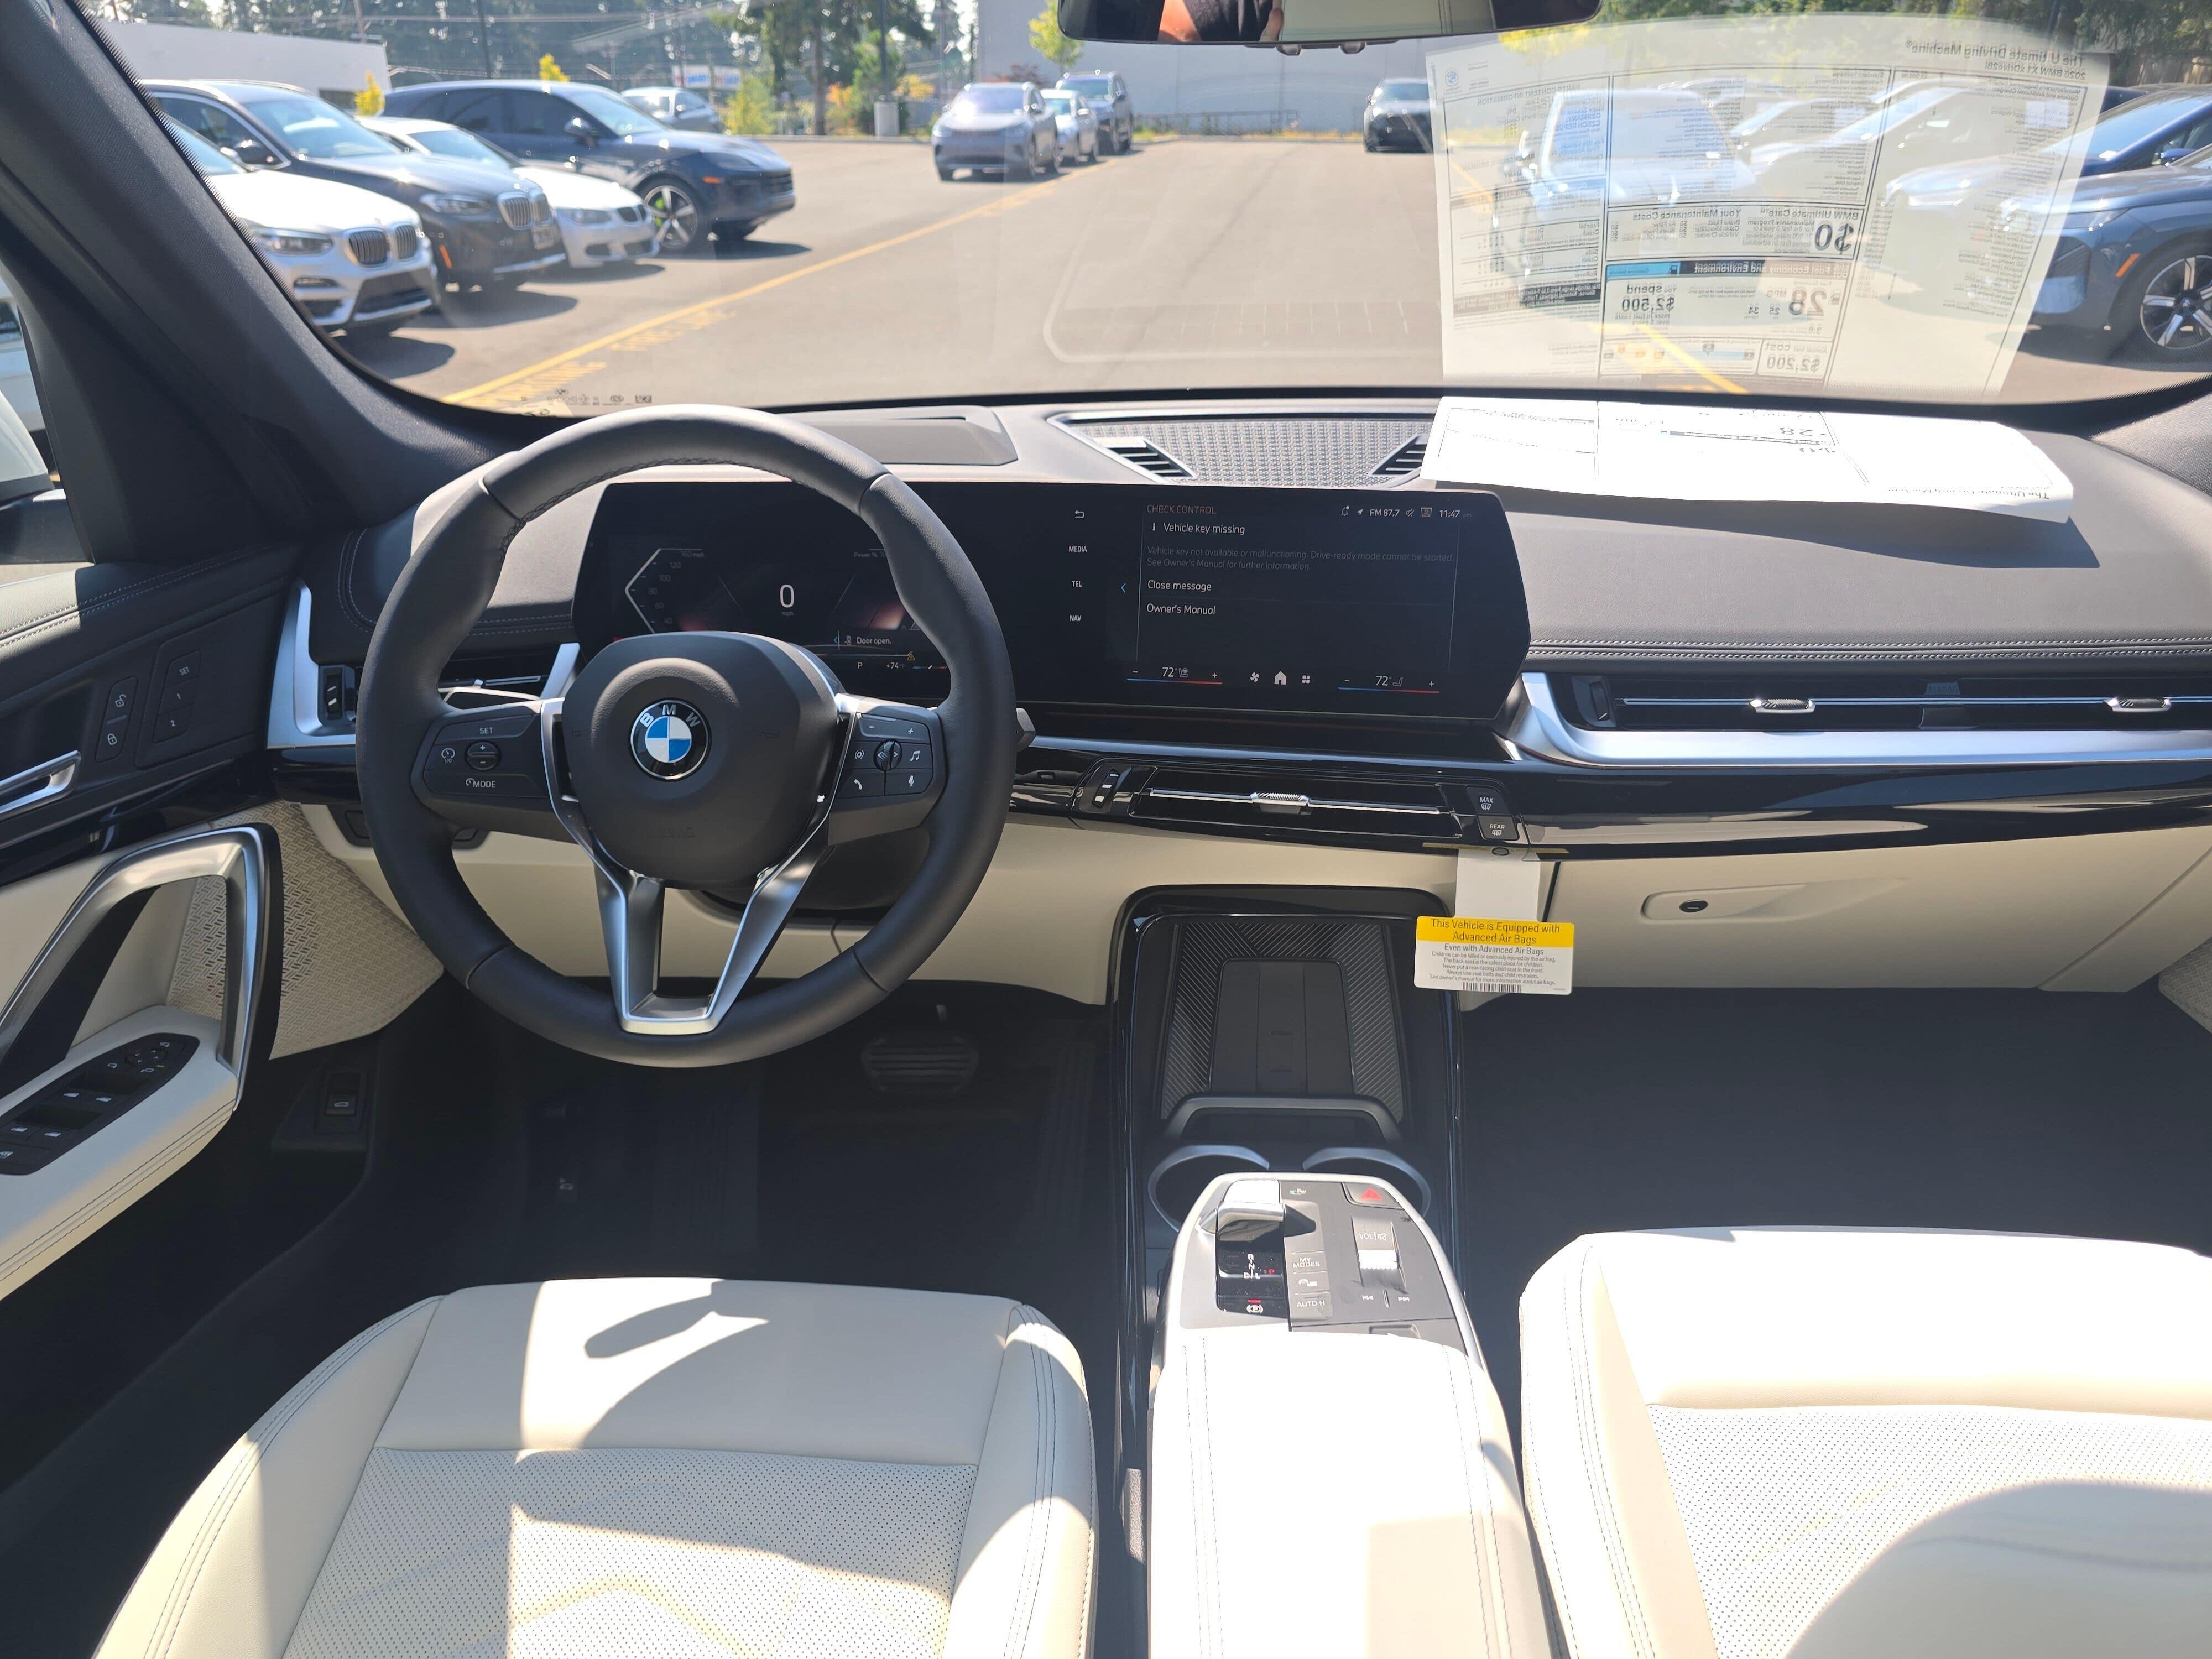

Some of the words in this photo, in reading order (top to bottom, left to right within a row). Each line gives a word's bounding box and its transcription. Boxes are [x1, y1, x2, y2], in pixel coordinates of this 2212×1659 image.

[1147, 505, 1175, 513] CHECK
[1176, 505, 1217, 514] CONTROL
[1439, 509, 1460, 518] 11:47
[1163, 523, 1193, 533] Vehicle
[1195, 524, 1211, 534] key
[1212, 525, 1245, 535] missing
[1147, 546, 1173, 555] Vehicle
[1176, 547, 1188, 556] key
[1206, 548, 1238, 557] available
[1250, 549, 1308, 560] malfunctioning.
[1311, 551, 1355, 561] Drive-ready
[1424, 553, 1454, 562] started.
[1164, 558, 1195, 567] Owner's
[1197, 559, 1225, 567] Manual
[1227, 560, 1237, 568] for
[1239, 560, 1264, 569] further
[1265, 561, 1312, 570] information.
[1147, 580, 1170, 589] Close
[1172, 582, 1212, 592] message
[779, 585, 795, 608] 0
[1147, 603, 1181, 613] Owner's
[1183, 604, 1215, 614] Manual
[179, 666, 190, 675] SET
[639, 704, 701, 728] BMW
[1431, 918, 1449, 928] This
[1452, 920, 1484, 930] Vehicle
[1487, 922, 1493, 930] is
[1496, 922, 1540, 933] Equipped
[1541, 924, 1559, 933] with
[1453, 931, 1496, 942] Advanced
[1499, 933, 1511, 942] Air
[1515, 934, 1536, 946] Bags
[1444, 943, 1461, 951] Even
[1479, 945, 1513, 953] Advanced
[1526, 947, 1544, 956] Bags
